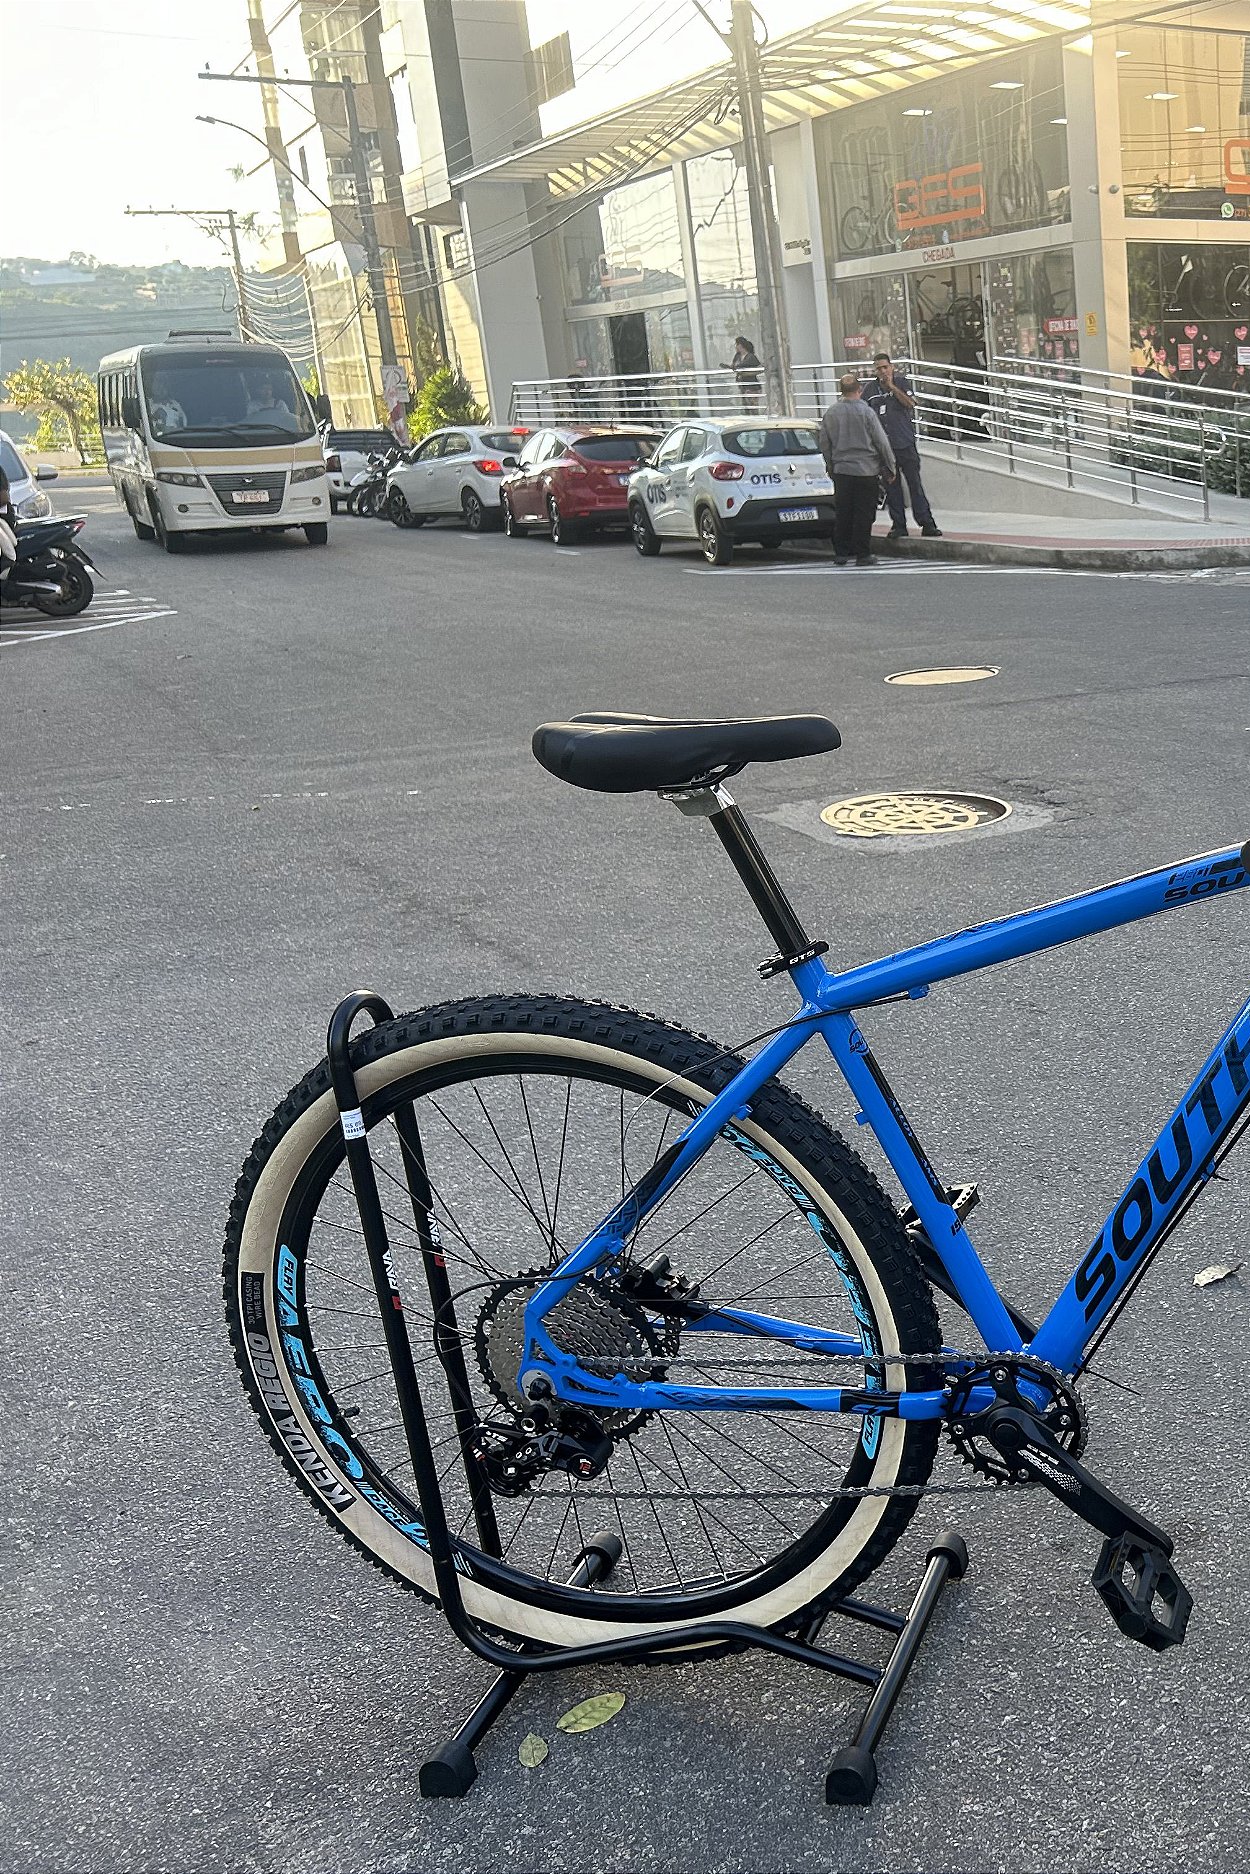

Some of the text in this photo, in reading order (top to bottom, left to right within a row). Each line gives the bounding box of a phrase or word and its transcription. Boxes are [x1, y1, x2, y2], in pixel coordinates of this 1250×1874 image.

[894, 162, 986, 231] GFS
[647, 483, 667, 504] OTIS
[750, 474, 782, 486] OTIS
[282, 1257, 297, 1297] FLAY
[254, 1281, 263, 1322] WIRE BEAD
[272, 1288, 364, 1480] AERO
[248, 1331, 354, 1506] KENDA REGIO
